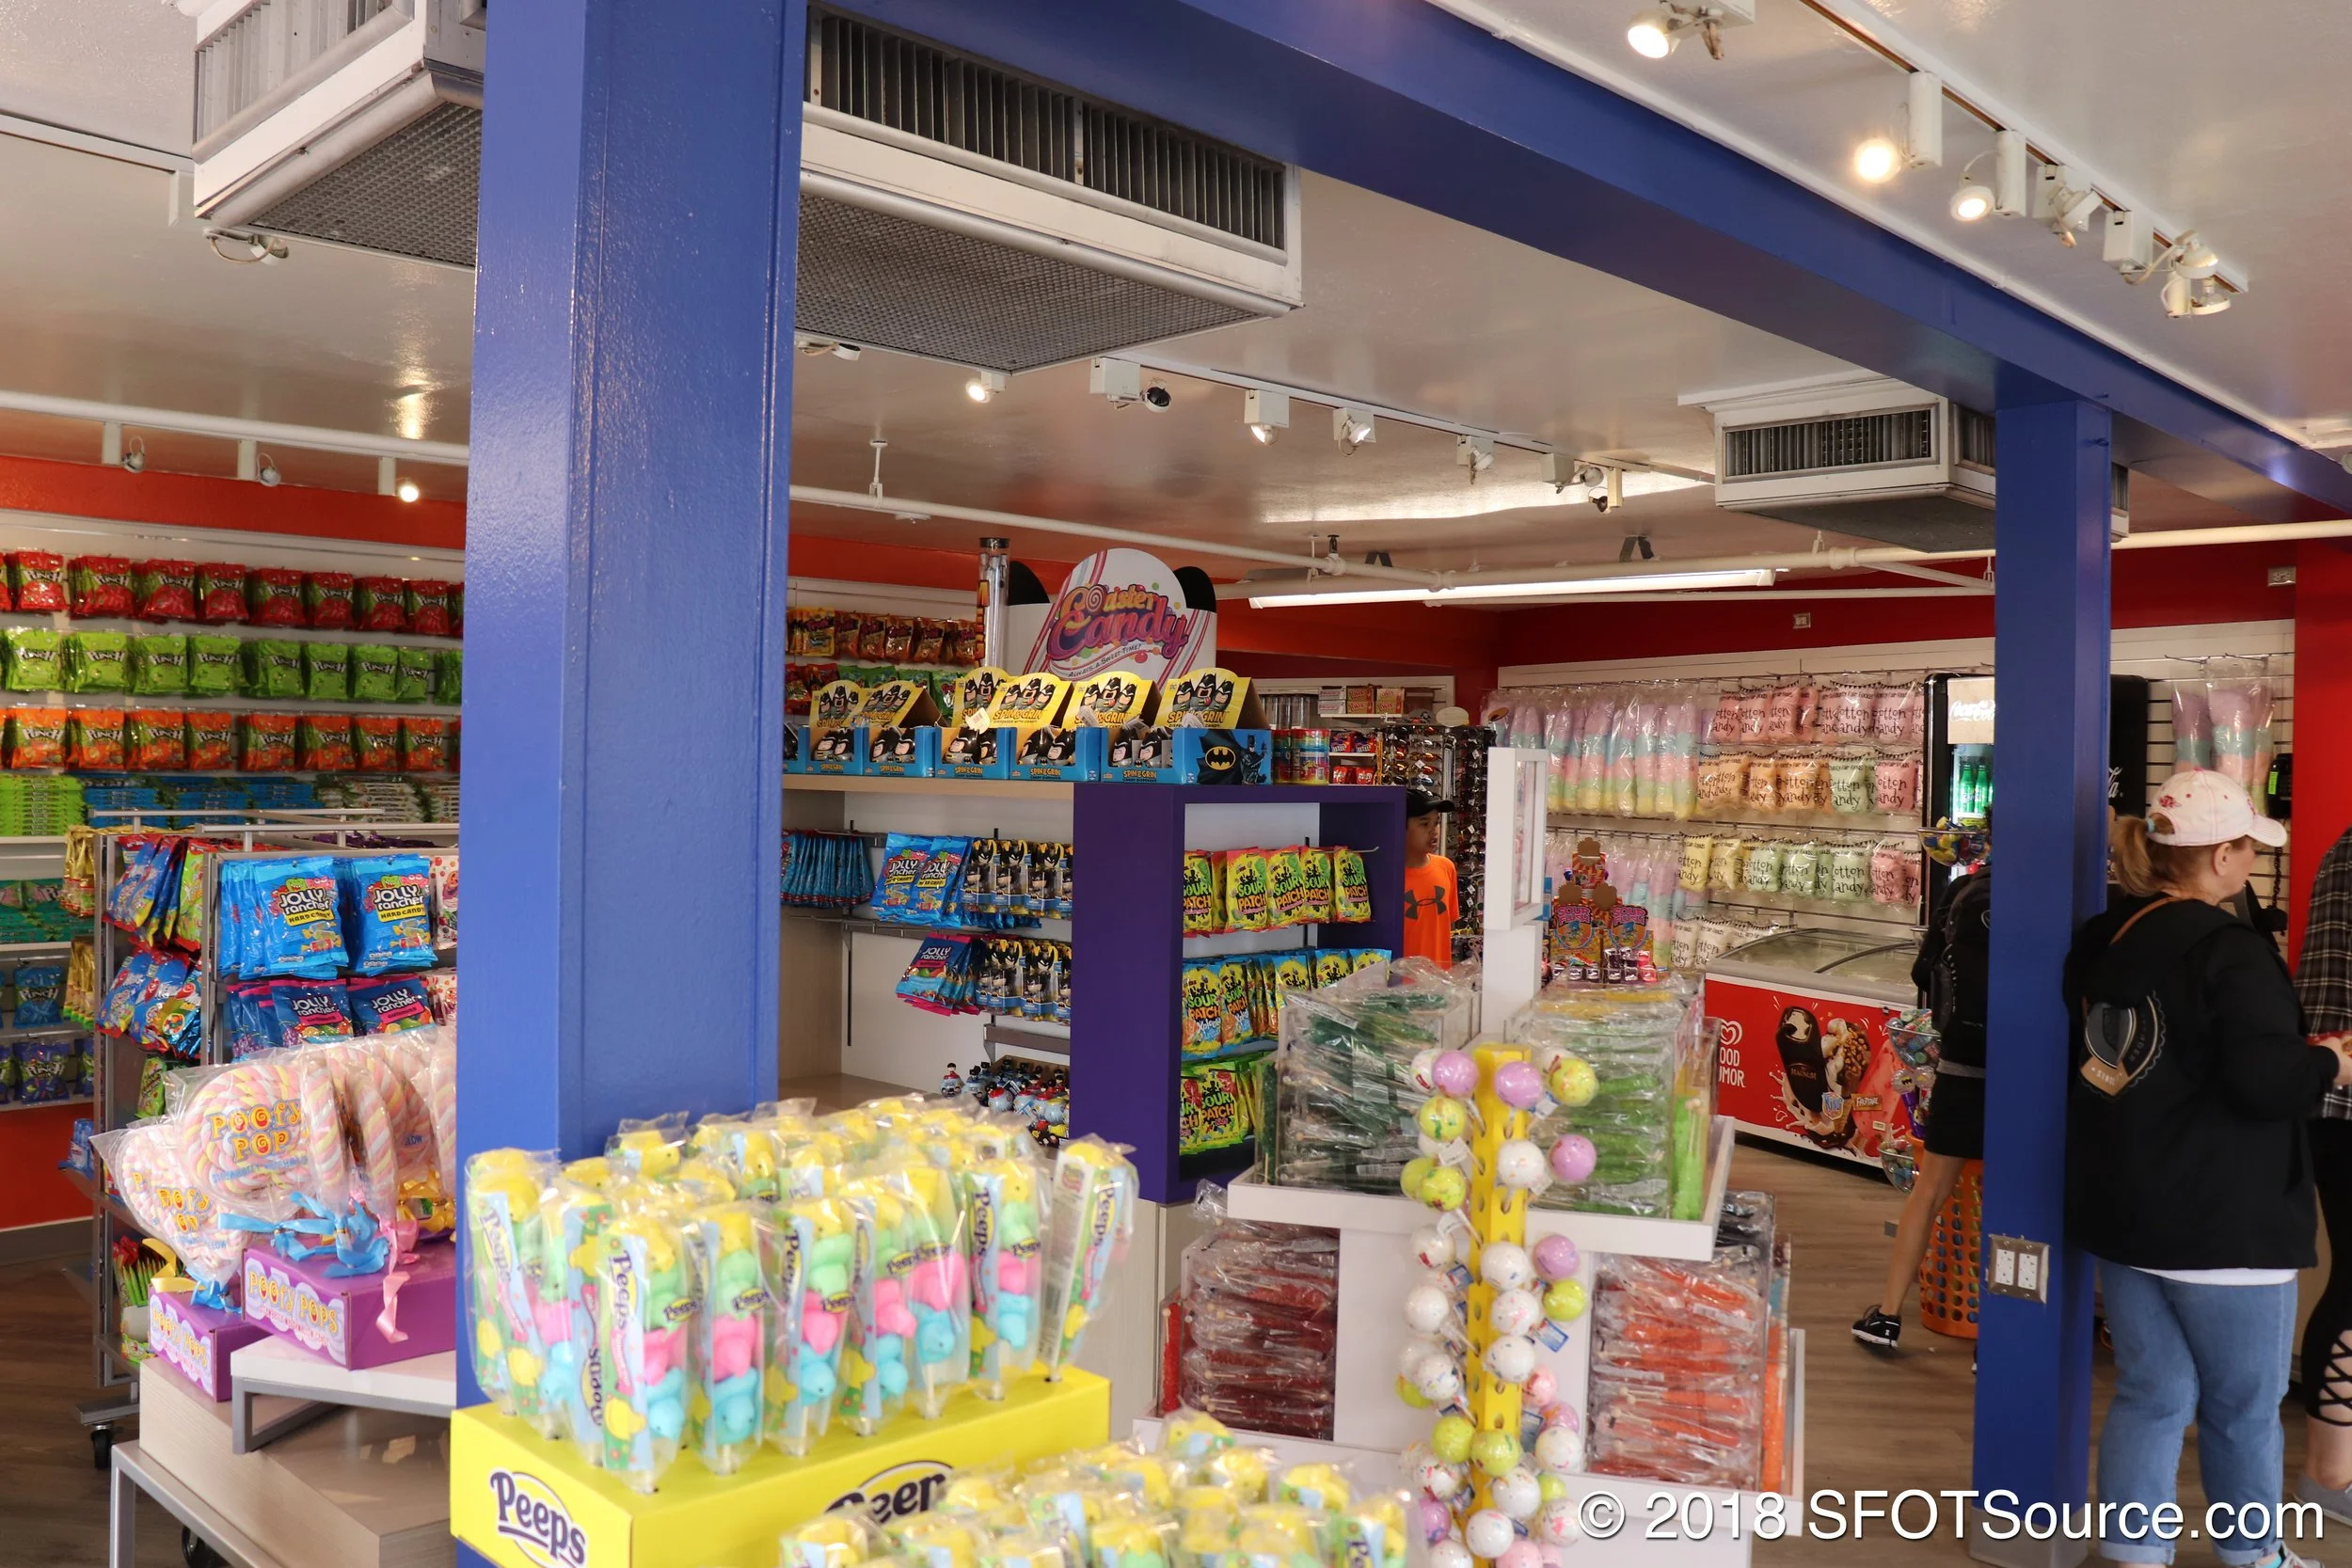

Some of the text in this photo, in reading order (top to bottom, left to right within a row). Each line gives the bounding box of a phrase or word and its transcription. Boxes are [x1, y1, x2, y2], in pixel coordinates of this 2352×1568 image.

[1047, 594, 1189, 660] Candy
[373, 885, 419, 904] JOLLY
[1237, 882, 1264, 897] SOUR
[1273, 877, 1301, 896] SOUR
[1344, 886, 1368, 897] PATCH
[280, 888, 325, 908] JOLLY
[378, 895, 424, 911] rancher
[1237, 895, 1266, 909] PATCH
[1275, 888, 1304, 907] PATCH
[284, 900, 330, 914] rancher
[381, 910, 401, 919] HARD
[289, 914, 310, 924] HARD
[923, 947, 952, 956] JOLLY
[292, 995, 328, 1011] JOLLY
[371, 989, 409, 1009] JOLLY
[377, 997, 417, 1014] rancher
[1187, 993, 1217, 1007] SOUR
[1188, 1006, 1221, 1021] PATCH
[1719, 1047, 1740, 1067] OOD
[1201, 1091, 1232, 1106] SOUR
[1201, 1104, 1234, 1119] PATCH
[232, 1130, 291, 1162] POP
[974, 1187, 992, 1256] Peeps
[612, 1250, 632, 1330] Peeps
[299, 1293, 338, 1334] POPS
[490, 1472, 585, 1564] Peeps
